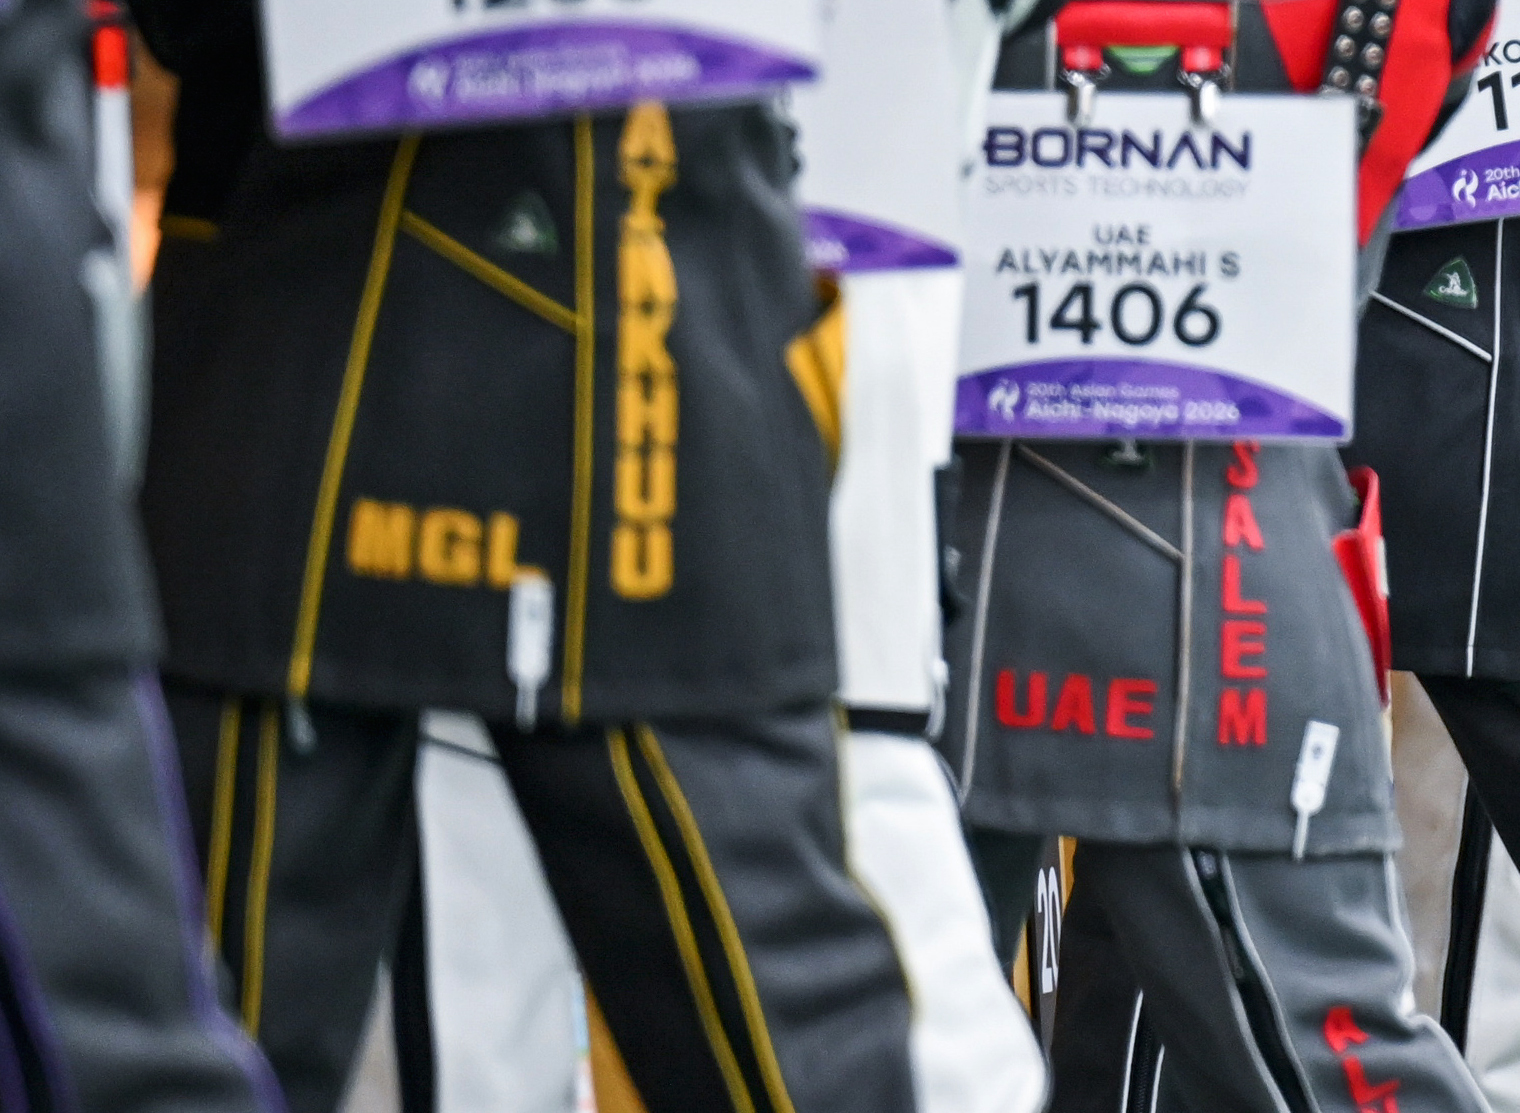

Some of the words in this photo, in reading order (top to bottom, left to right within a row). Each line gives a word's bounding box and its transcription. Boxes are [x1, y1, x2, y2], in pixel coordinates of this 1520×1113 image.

[982, 126, 1253, 171] BORNAN
[1485, 166, 1520, 183] 20th
[1094, 224, 1152, 246] UAE
[996, 248, 1206, 276] ALYAMMAHI
[1220, 251, 1241, 277] S
[1011, 281, 1222, 347] 1406
[1183, 399, 1242, 426] 2026
[1218, 441, 1269, 747] SALEM
[995, 669, 1157, 740] UAE
[1037, 866, 1062, 994] 20
